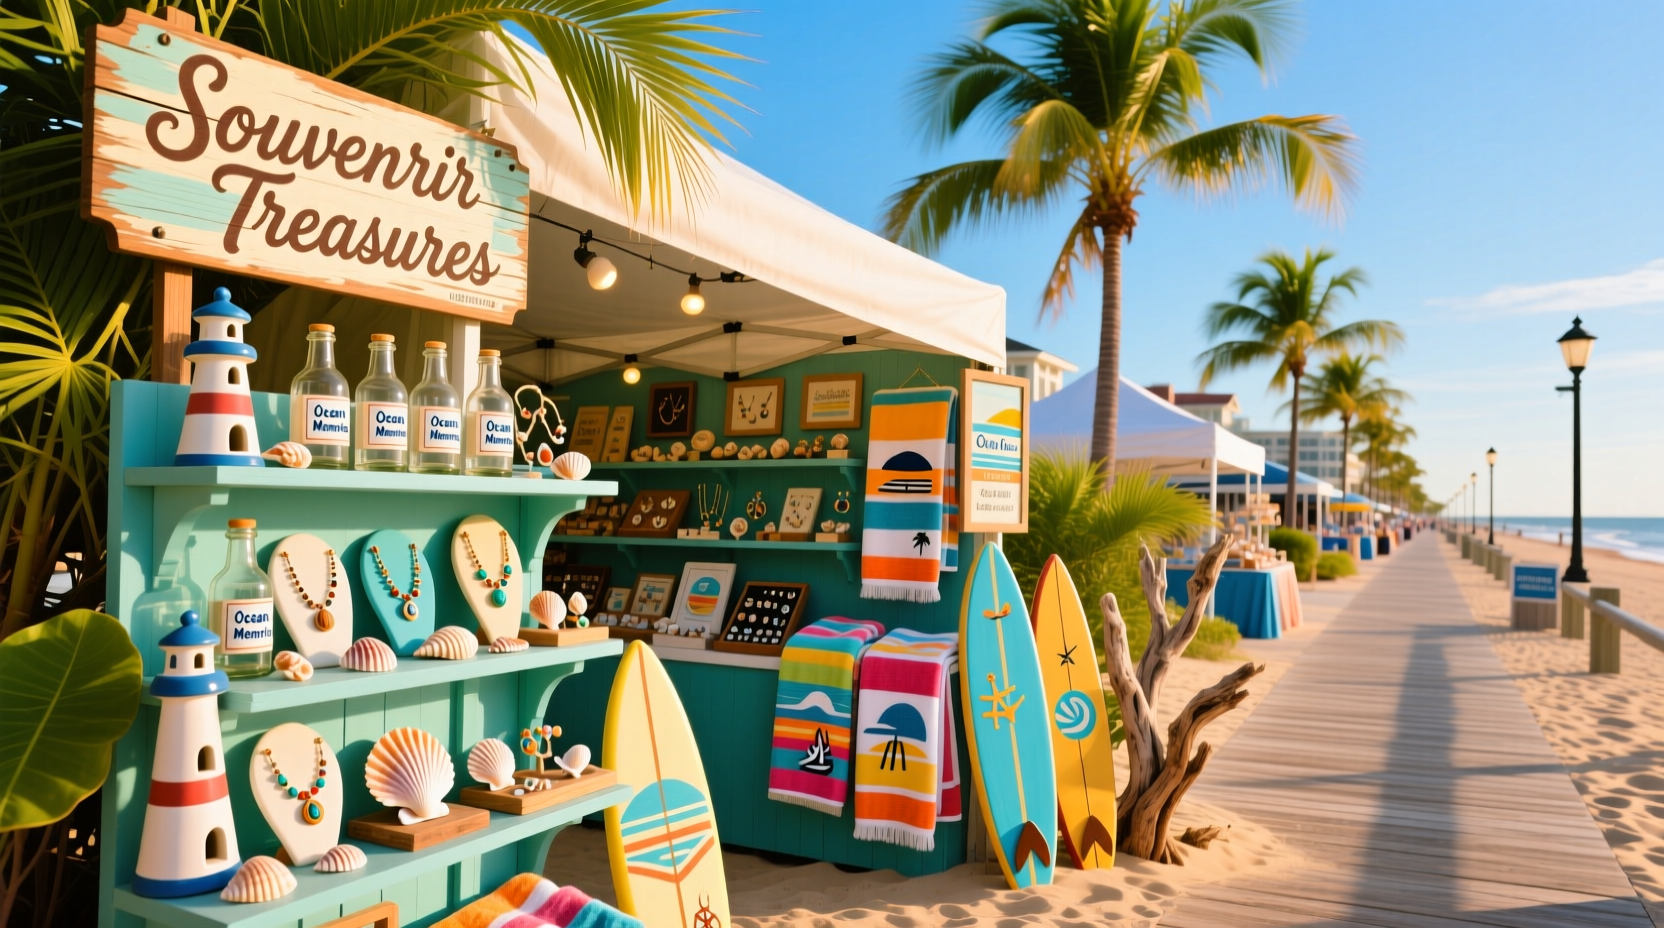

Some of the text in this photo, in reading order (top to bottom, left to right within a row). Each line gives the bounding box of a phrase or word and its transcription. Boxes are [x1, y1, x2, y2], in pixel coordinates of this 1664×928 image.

[145, 54, 481, 210] Souvenrir
[211, 163, 501, 286] Treasures
[234, 610, 269, 624] Ocean
